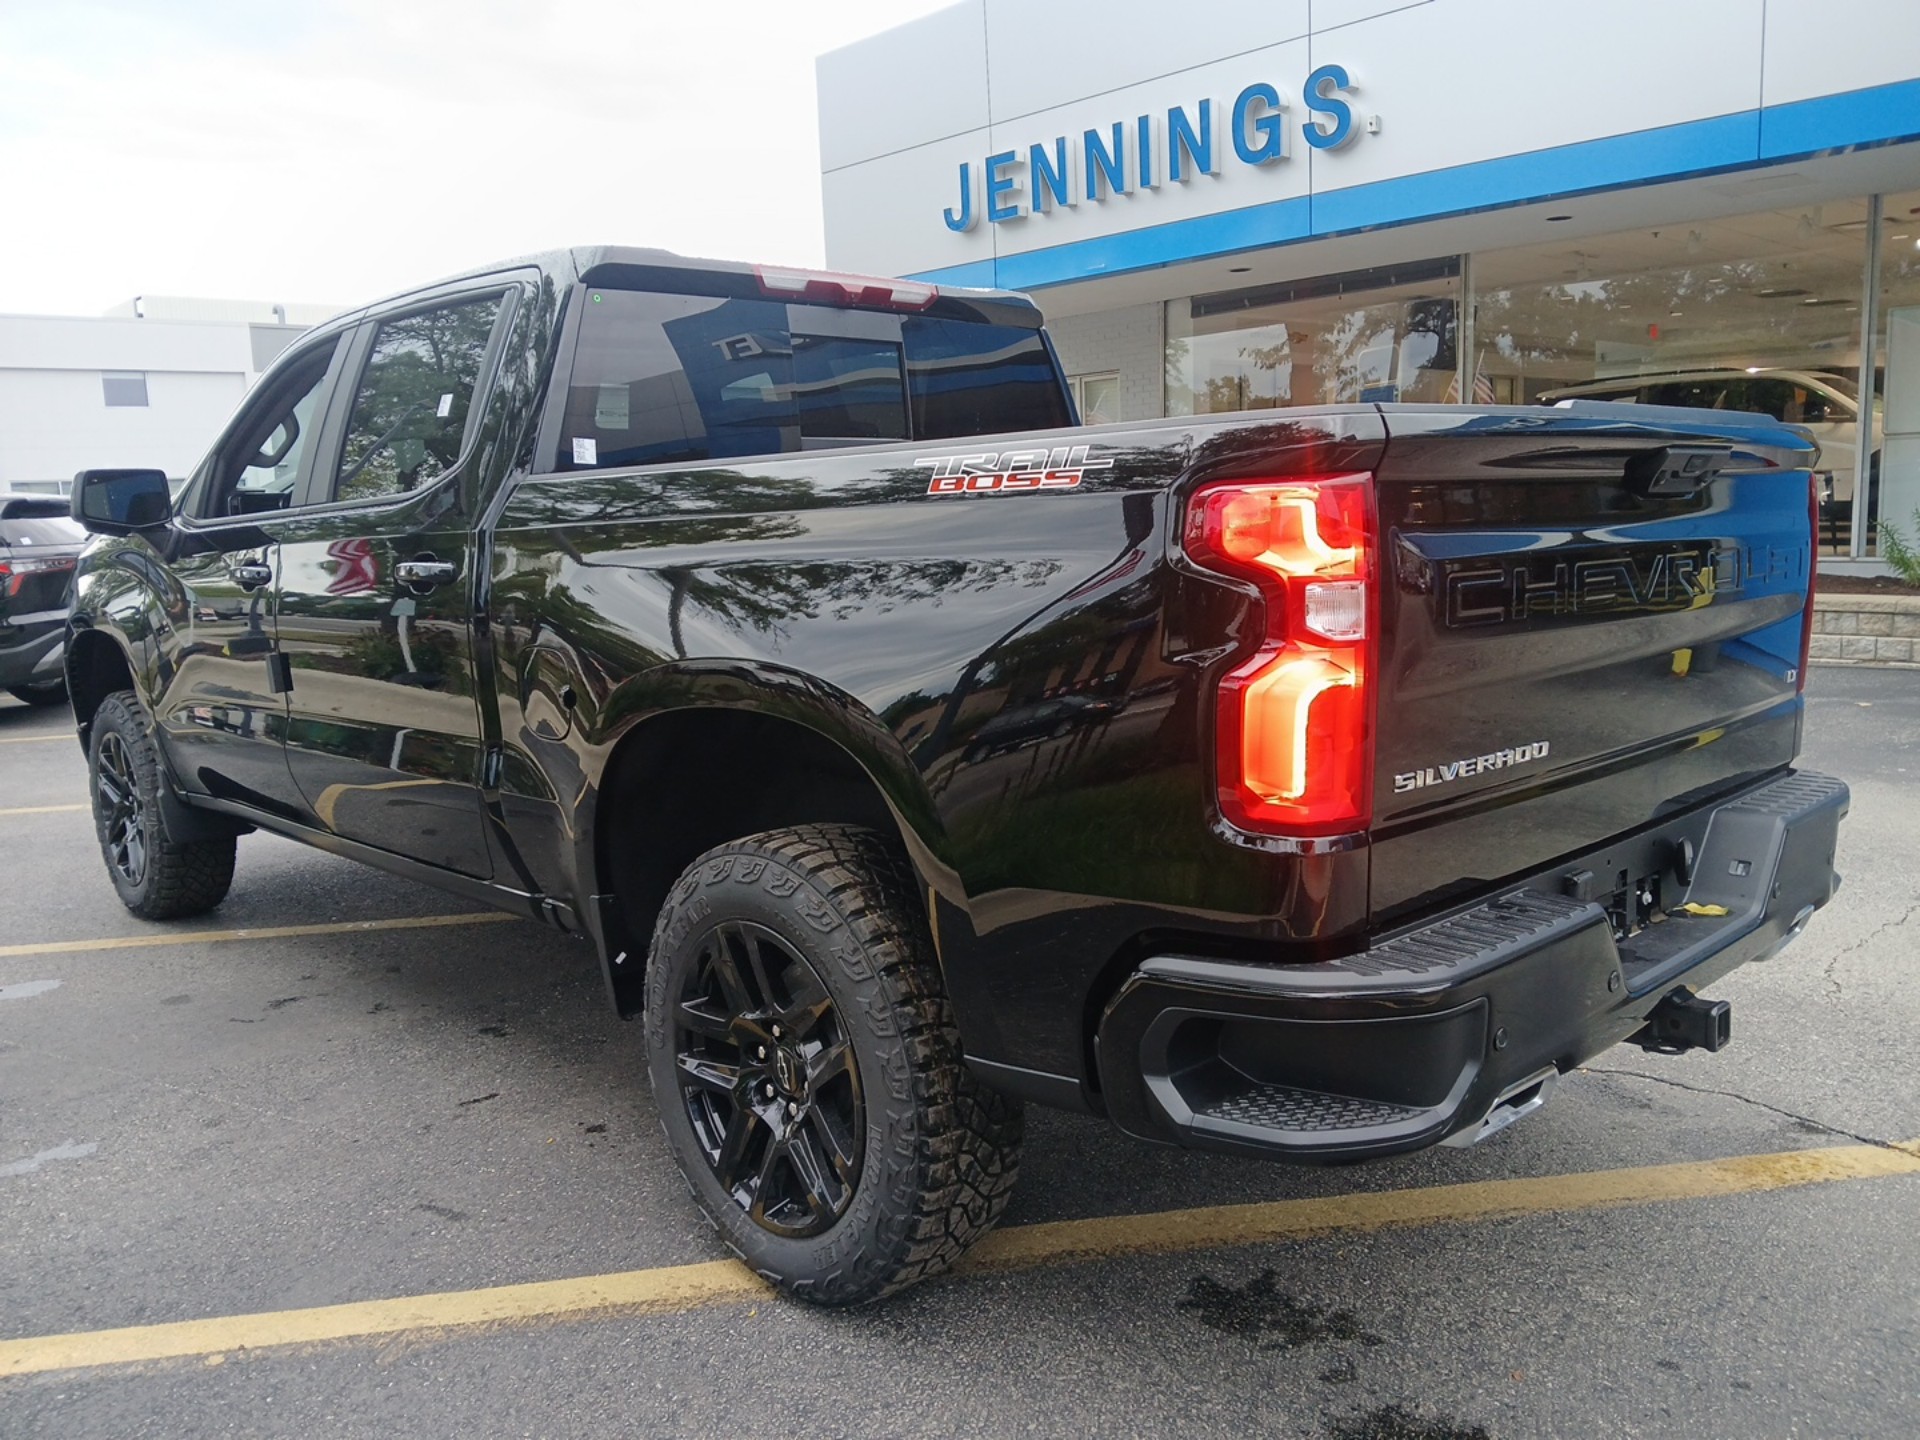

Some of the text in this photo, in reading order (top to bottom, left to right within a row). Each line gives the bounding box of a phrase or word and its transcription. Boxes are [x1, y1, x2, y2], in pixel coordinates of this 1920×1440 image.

[943, 64, 1358, 233] JENNINGS
[913, 444, 1115, 477] TRAIL
[926, 468, 1085, 495] BOSS
[1393, 740, 1550, 793] SILVERADO
